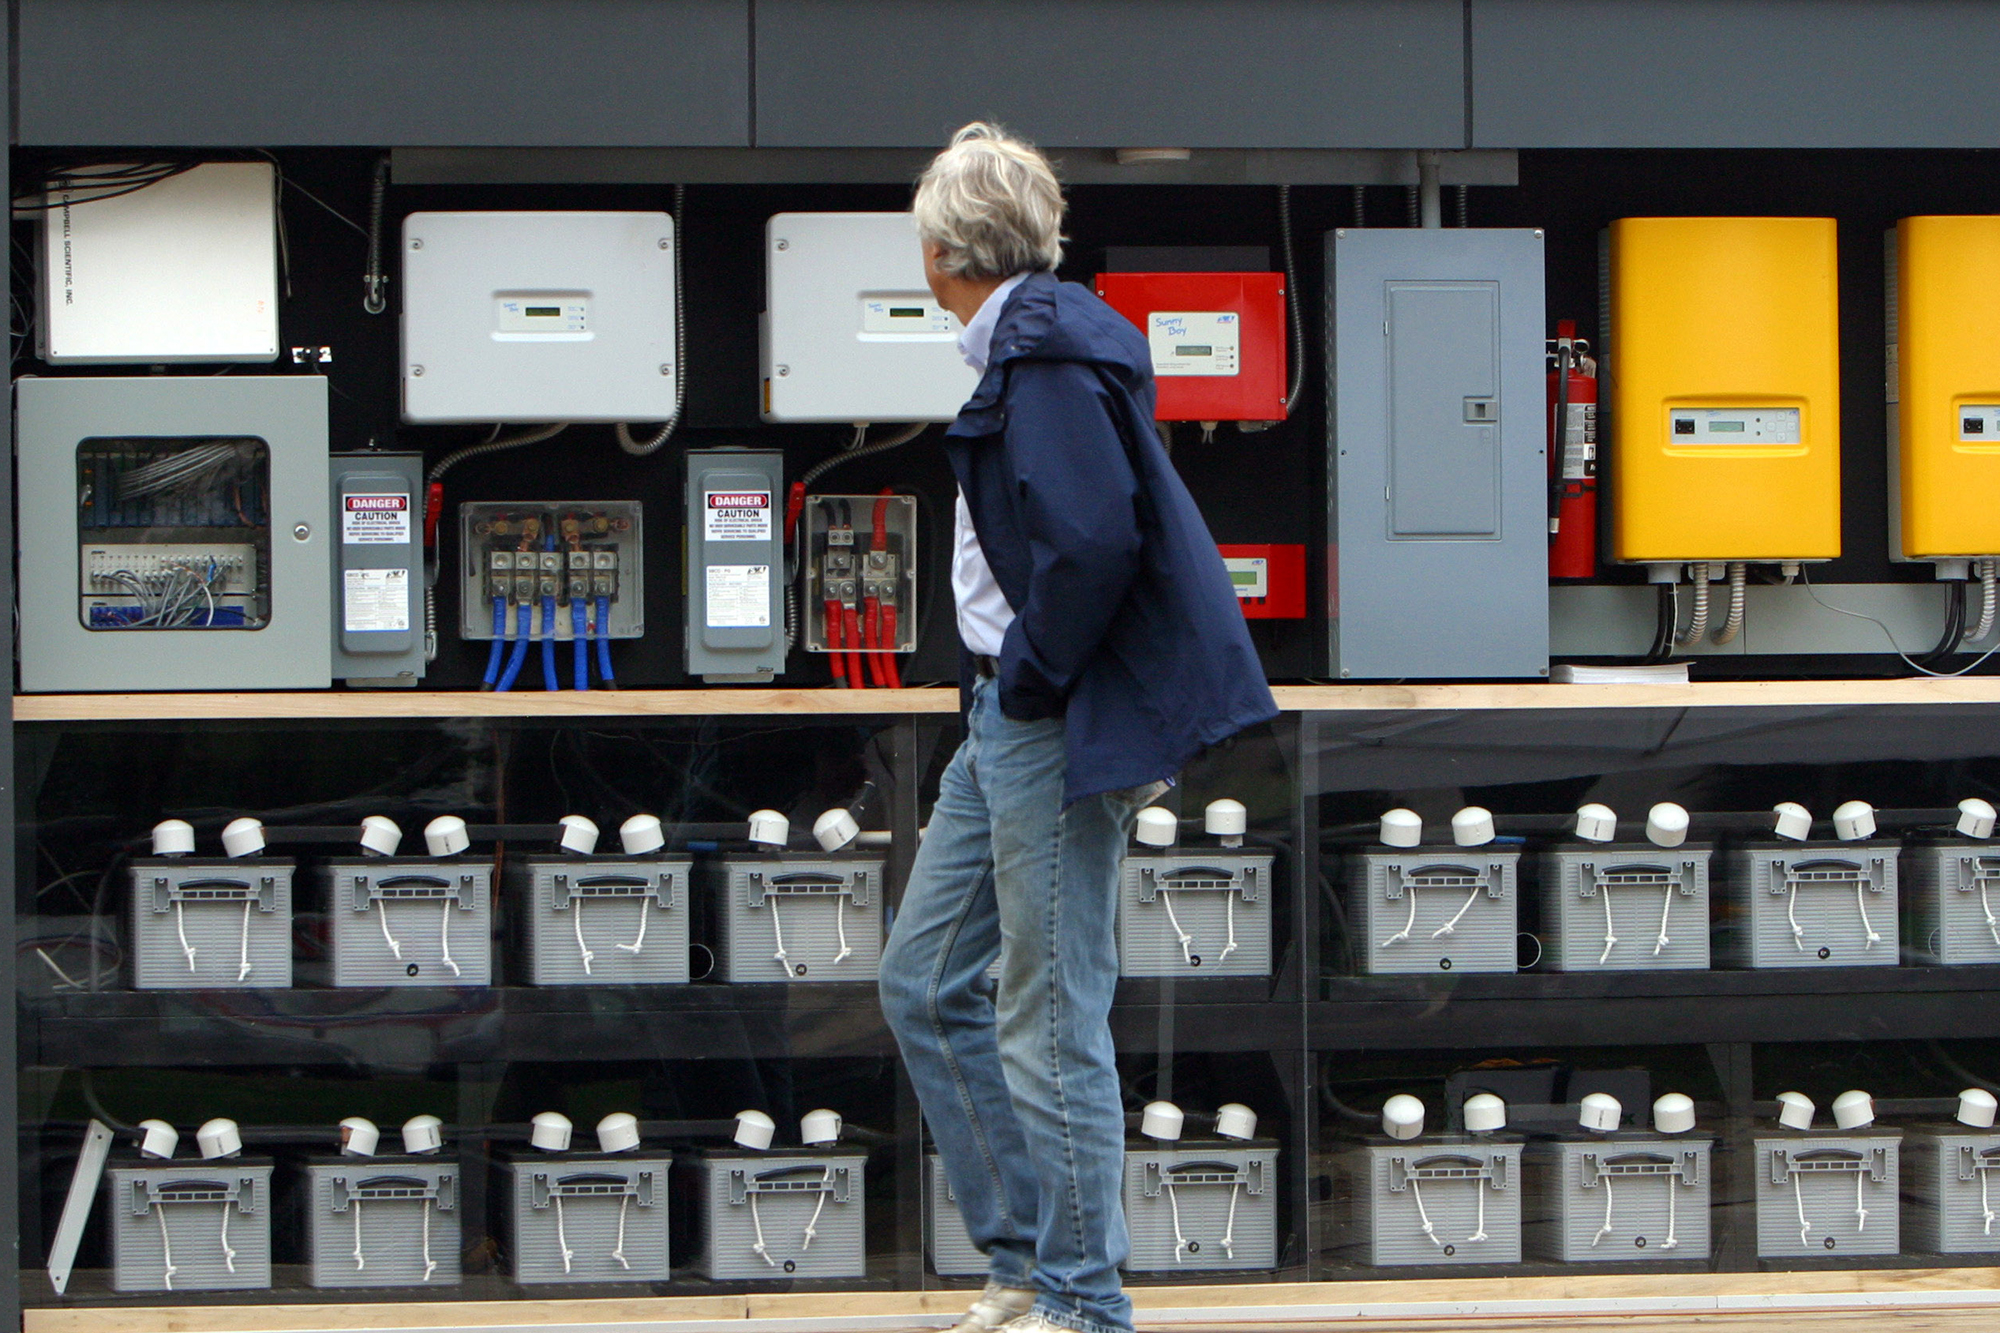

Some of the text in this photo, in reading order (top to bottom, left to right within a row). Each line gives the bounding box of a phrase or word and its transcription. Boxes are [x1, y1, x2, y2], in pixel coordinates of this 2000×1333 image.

[64, 240, 73, 288] SCIENTIFIC,
[65, 289, 73, 306] INC.
[1155, 317, 1183, 327] Sunny
[1168, 326, 1187, 336] Boy
[352, 499, 400, 509] DANGER
[715, 496, 762, 506] DANGER
[354, 512, 398, 521] CAUTION
[717, 509, 760, 518] CAUTION
